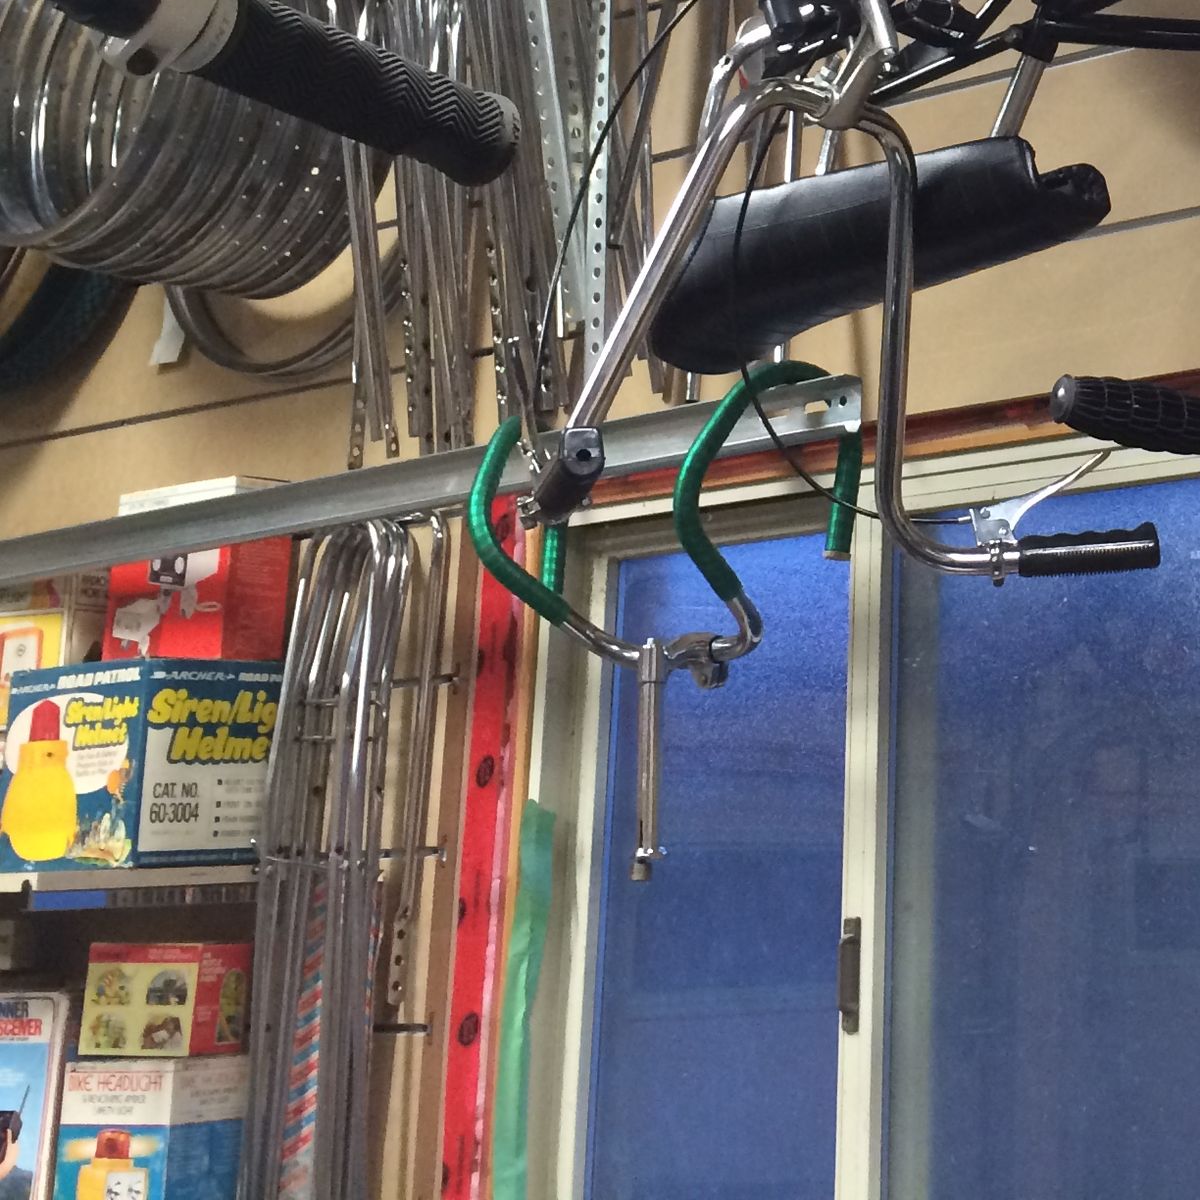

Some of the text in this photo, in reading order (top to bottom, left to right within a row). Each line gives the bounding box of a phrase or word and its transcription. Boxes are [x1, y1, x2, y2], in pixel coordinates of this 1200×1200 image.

[94, 667, 141, 685] PATROL
[166, 671, 225, 680] ARCHER
[149, 802, 199, 824] 60-3004
